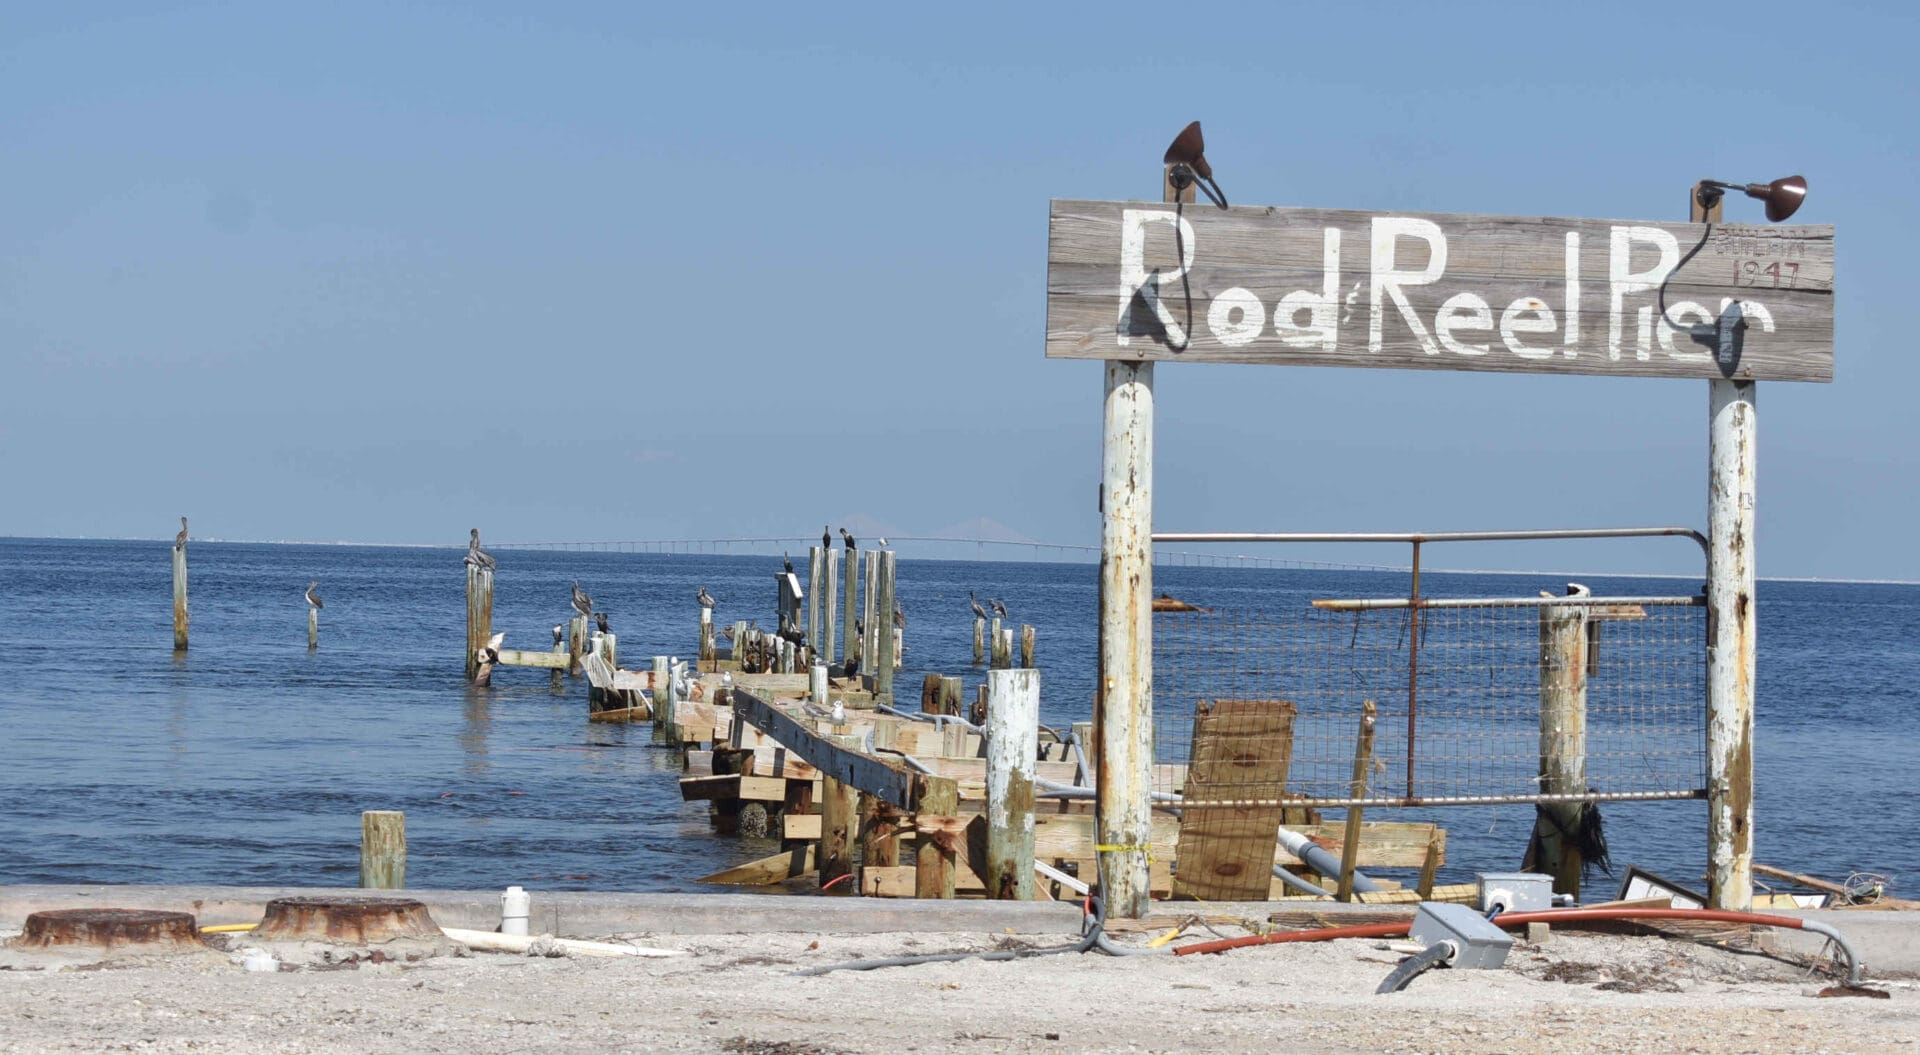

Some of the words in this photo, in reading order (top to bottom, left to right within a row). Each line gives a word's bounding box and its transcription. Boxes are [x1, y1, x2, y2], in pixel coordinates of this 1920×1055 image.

[1117, 208, 1341, 351] Rod
[1368, 217, 1580, 360] Reel
[1608, 225, 1776, 363] Pier
[1733, 260, 1800, 289] 1947
